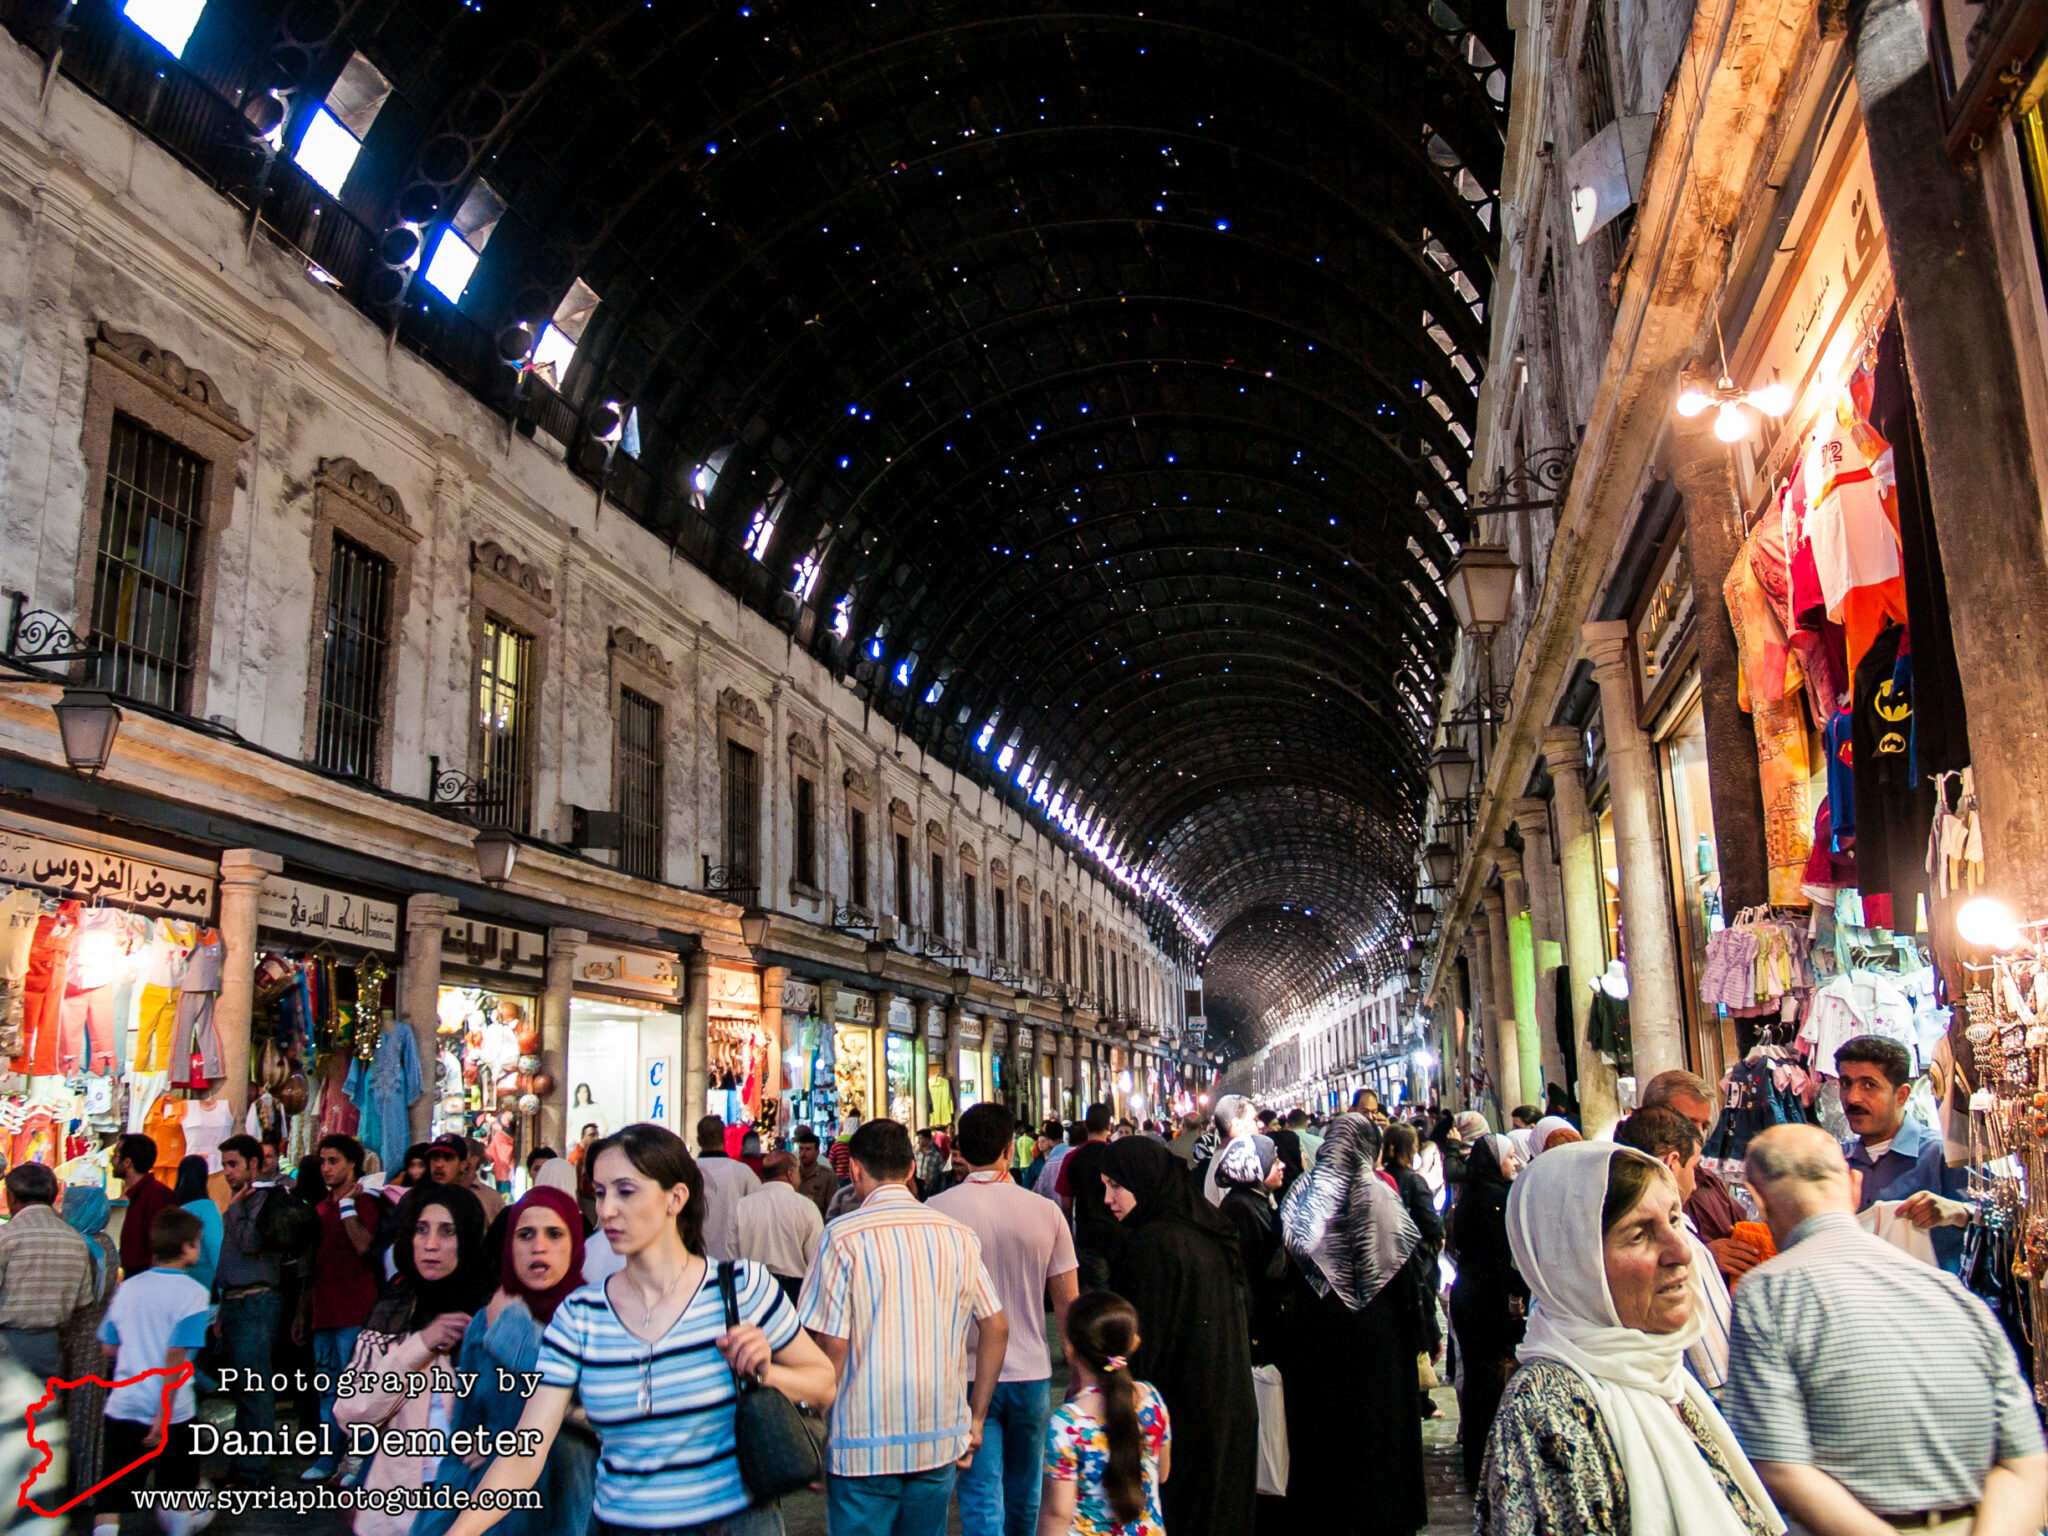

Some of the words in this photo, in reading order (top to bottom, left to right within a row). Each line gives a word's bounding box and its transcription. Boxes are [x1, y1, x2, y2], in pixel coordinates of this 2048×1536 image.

[33, 856, 133, 897] الفردوس
[135, 869, 207, 909] معرض
[290, 887, 330, 929] الشرقي
[330, 896, 370, 938] المتحف
